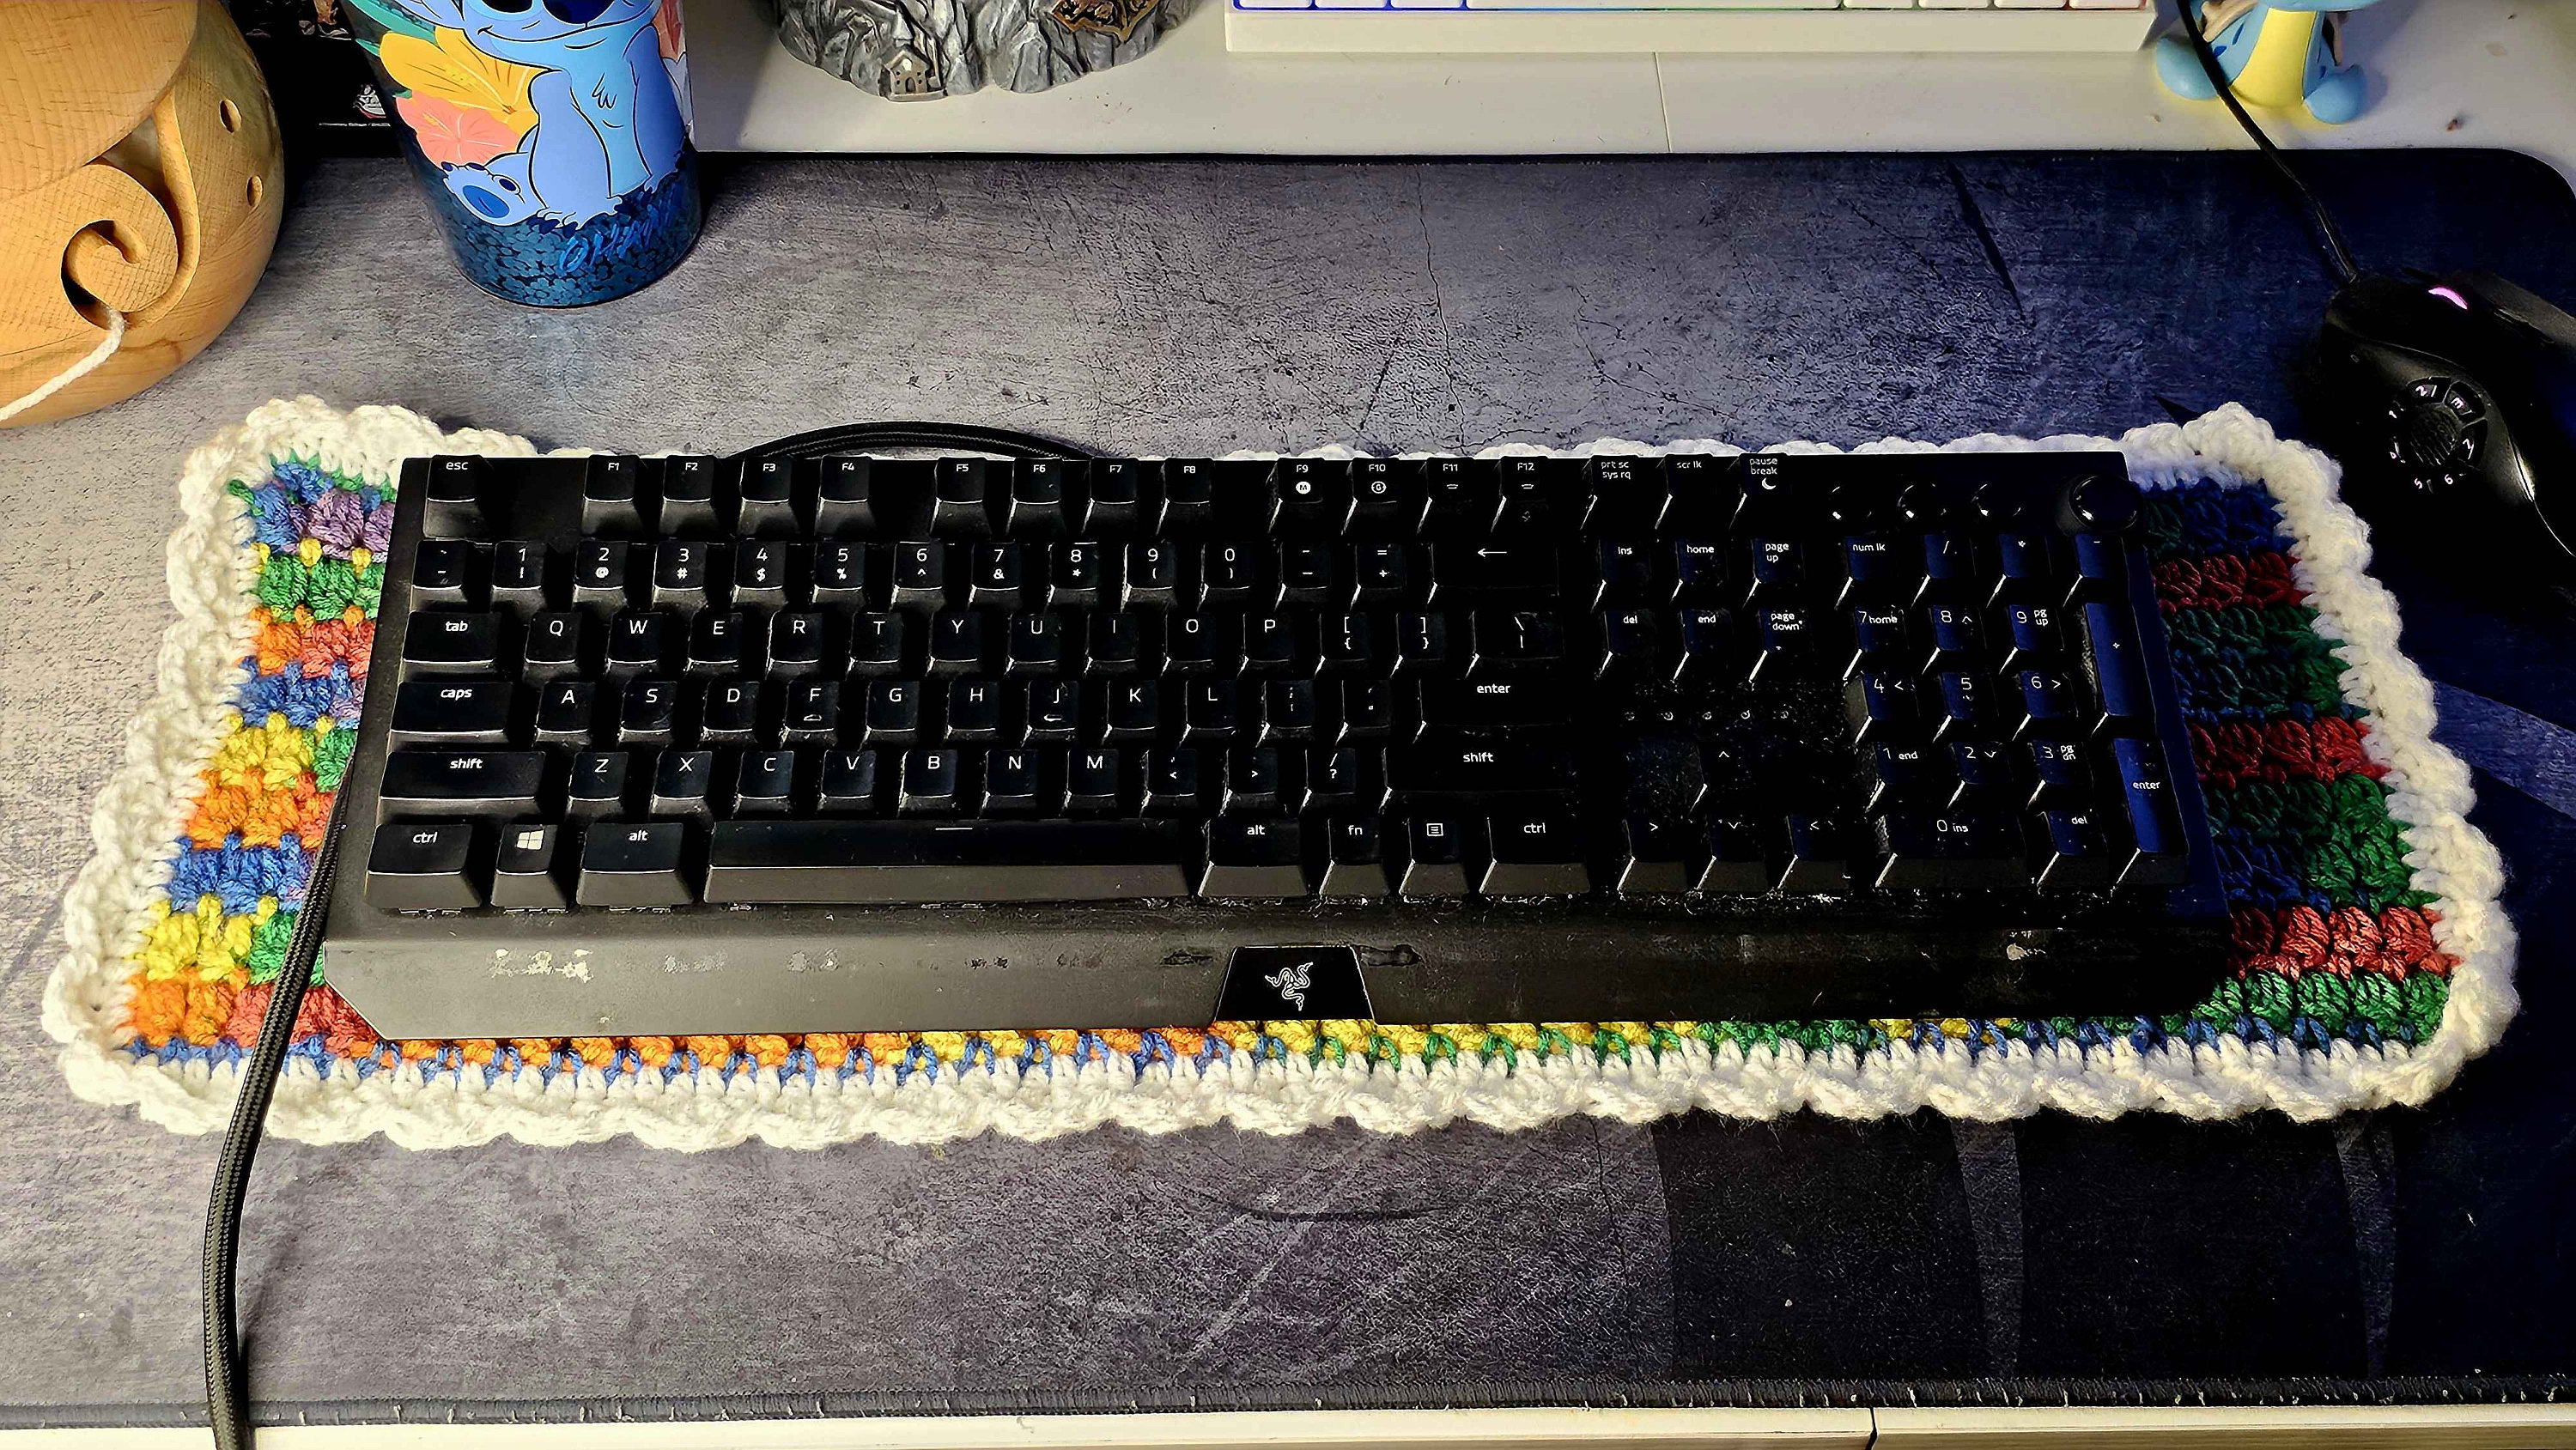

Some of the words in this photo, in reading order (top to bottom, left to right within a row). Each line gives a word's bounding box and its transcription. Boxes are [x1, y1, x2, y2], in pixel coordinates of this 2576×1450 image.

[446, 461, 469, 470] esc
[607, 462, 620, 471] F1
[684, 462, 698, 471] F2
[762, 463, 776, 472] F3
[841, 462, 855, 471] F4
[956, 463, 969, 472] F5
[1033, 464, 1046, 473] F6
[1109, 464, 1122, 473] F7
[1296, 464, 1309, 473] F9
[1368, 464, 1386, 472] F10
[1443, 463, 1458, 472] F11
[1517, 462, 1535, 471] F12
[1601, 460, 1617, 470] prt
[1692, 460, 1702, 469] lk
[1749, 458, 1778, 466] pause
[1183, 465, 1196, 474] F8
[1602, 471, 1619, 480] sys
[1620, 471, 1631, 480] rq
[1750, 465, 1777, 476] break
[598, 547, 610, 561] 2
[756, 547, 769, 561] 4
[1618, 546, 1633, 555] ins
[1686, 544, 1715, 554] home
[1765, 543, 1789, 553] page
[1852, 543, 1874, 552] num
[1875, 543, 1886, 551] lk
[518, 548, 526, 561] 1
[677, 548, 690, 562] 3
[837, 548, 848, 562] 5
[916, 548, 927, 562] 6
[993, 549, 1005, 562] 7
[1070, 549, 1082, 563] 8
[1147, 548, 1159, 562] 9
[1224, 548, 1236, 561] 0
[1766, 554, 1779, 563] up
[1623, 615, 1638, 624] del
[1698, 615, 1716, 623] end
[1771, 612, 1795, 622] page
[1858, 610, 1868, 623] 7
[1868, 616, 1898, 625] home
[1940, 610, 1953, 623] 8
[2016, 610, 2027, 624] 9
[2035, 618, 2049, 628] up
[445, 620, 469, 632] tab
[549, 620, 564, 637] Q
[629, 619, 648, 634] W
[713, 621, 726, 635] E
[793, 619, 806, 634] R
[872, 621, 886, 635] T
[951, 619, 964, 634] Y
[1030, 620, 1043, 634] U
[1185, 618, 1199, 634] O
[1264, 618, 1276, 634] P
[1771, 622, 1800, 631] down
[1476, 683, 1511, 694] enter
[1874, 678, 1885, 693] 4
[1960, 677, 1972, 690] 5
[2031, 676, 2042, 689] 6
[440, 689, 473, 701] caps
[561, 689, 575, 704] A
[645, 688, 659, 703] S
[726, 688, 741, 703] D
[809, 688, 822, 702] F
[889, 688, 902, 702] G
[969, 688, 984, 702] H
[1053, 688, 1060, 704] J
[1129, 688, 1141, 703] K
[1207, 687, 1218, 701] L
[1462, 751, 1494, 762] shift
[1899, 750, 1918, 760] end
[1965, 746, 1977, 759] 2
[2042, 745, 2054, 759] 3
[449, 757, 483, 769] shift
[594, 758, 610, 773] Z
[678, 757, 695, 772] X
[763, 757, 777, 772] C
[846, 755, 860, 770] V
[927, 755, 940, 770] B
[1008, 755, 1022, 770] N
[1086, 755, 1103, 769] M
[2132, 781, 2160, 790] enter
[1936, 819, 1948, 832] 0
[1952, 822, 1969, 833] ins
[2071, 816, 2088, 825] del
[1247, 824, 1266, 835] alt
[1347, 824, 1363, 836] fn
[1523, 822, 1546, 834] ctrl
[412, 831, 438, 844] ctrl
[629, 829, 648, 841] alt
